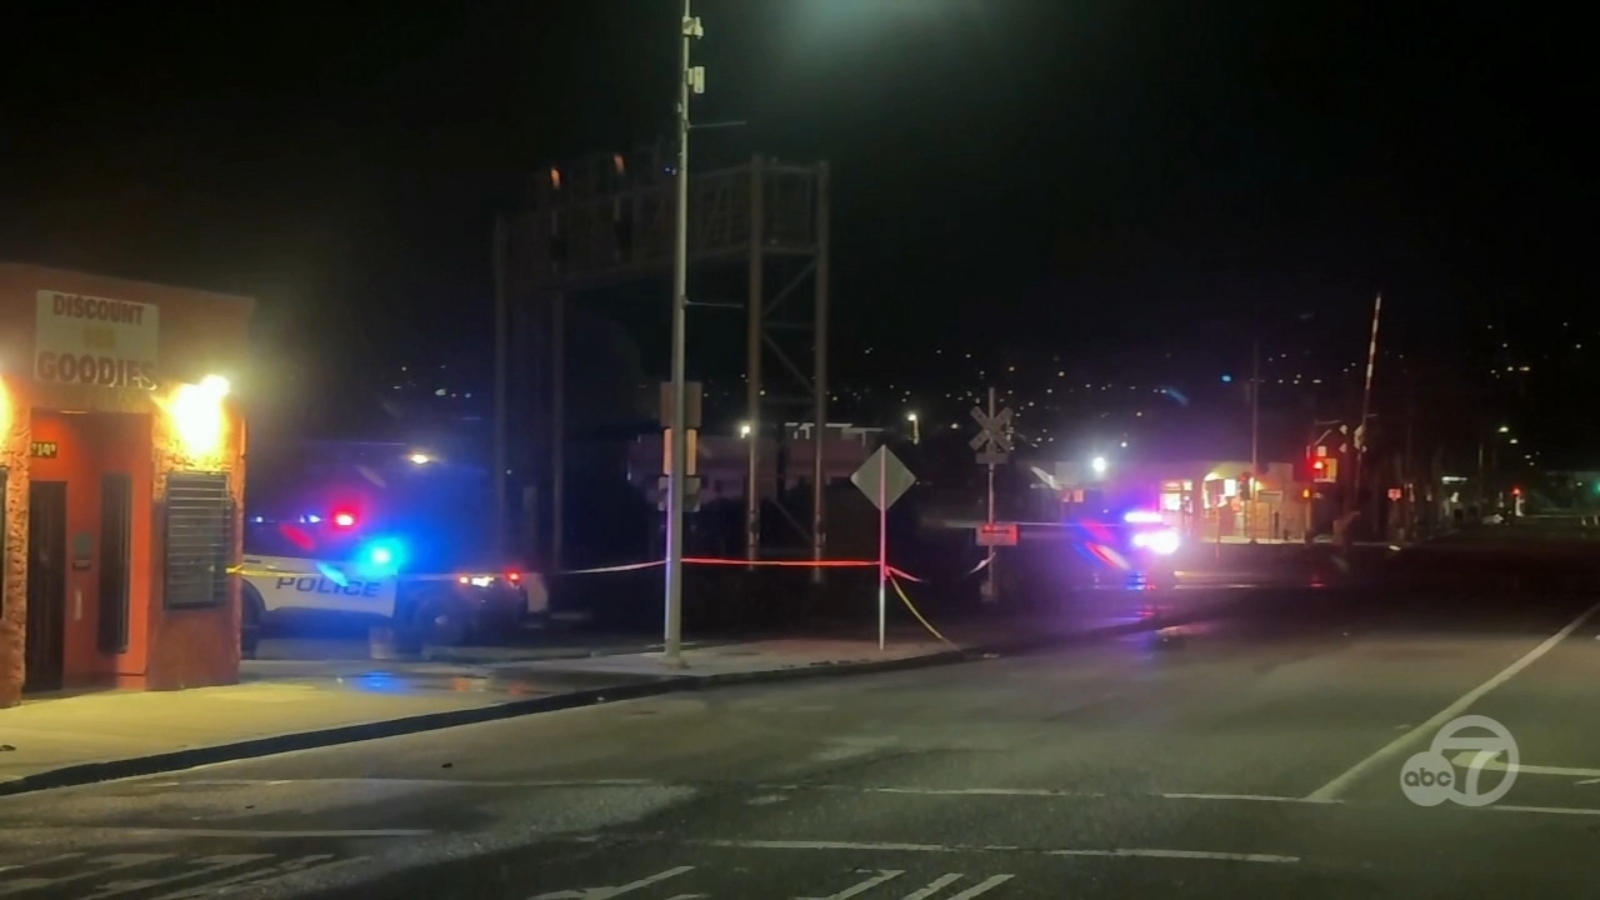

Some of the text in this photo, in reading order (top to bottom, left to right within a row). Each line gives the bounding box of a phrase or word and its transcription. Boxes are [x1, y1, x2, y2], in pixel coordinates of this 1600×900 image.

[53, 294, 145, 325] DISCOUNT
[37, 351, 157, 390] GOODIES
[276, 576, 381, 598] POLICE
